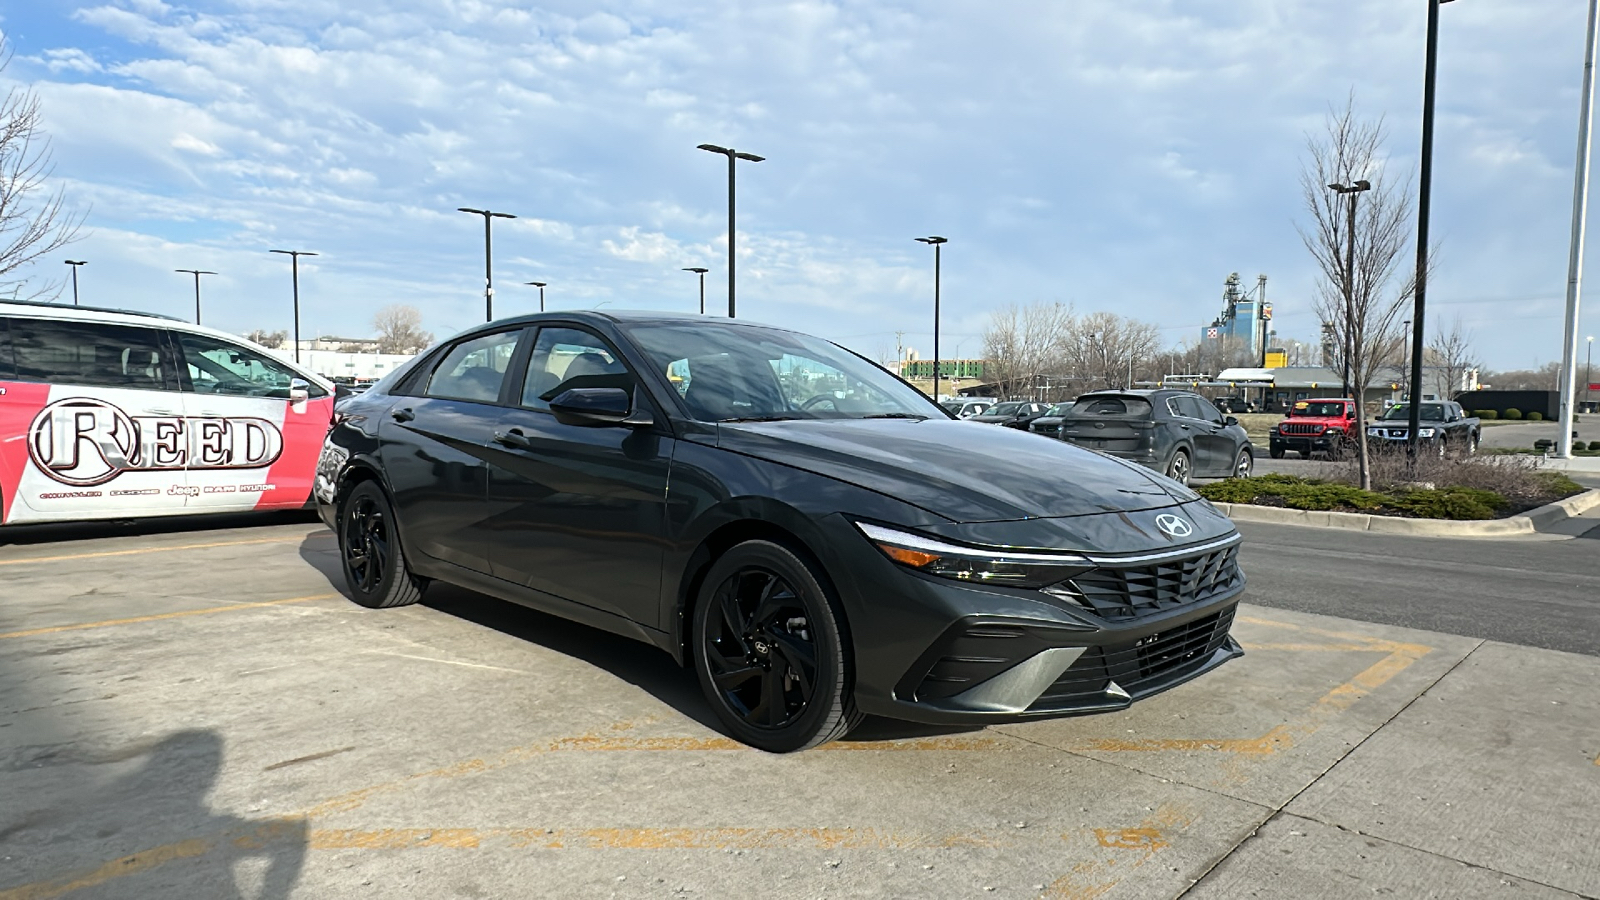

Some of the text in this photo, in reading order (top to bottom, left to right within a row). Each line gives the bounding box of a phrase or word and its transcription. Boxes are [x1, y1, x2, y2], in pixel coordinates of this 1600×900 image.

[36, 400, 282, 480] REED
[167, 484, 200, 497] Jeep
[239, 484, 276, 492] HYUNDAI
